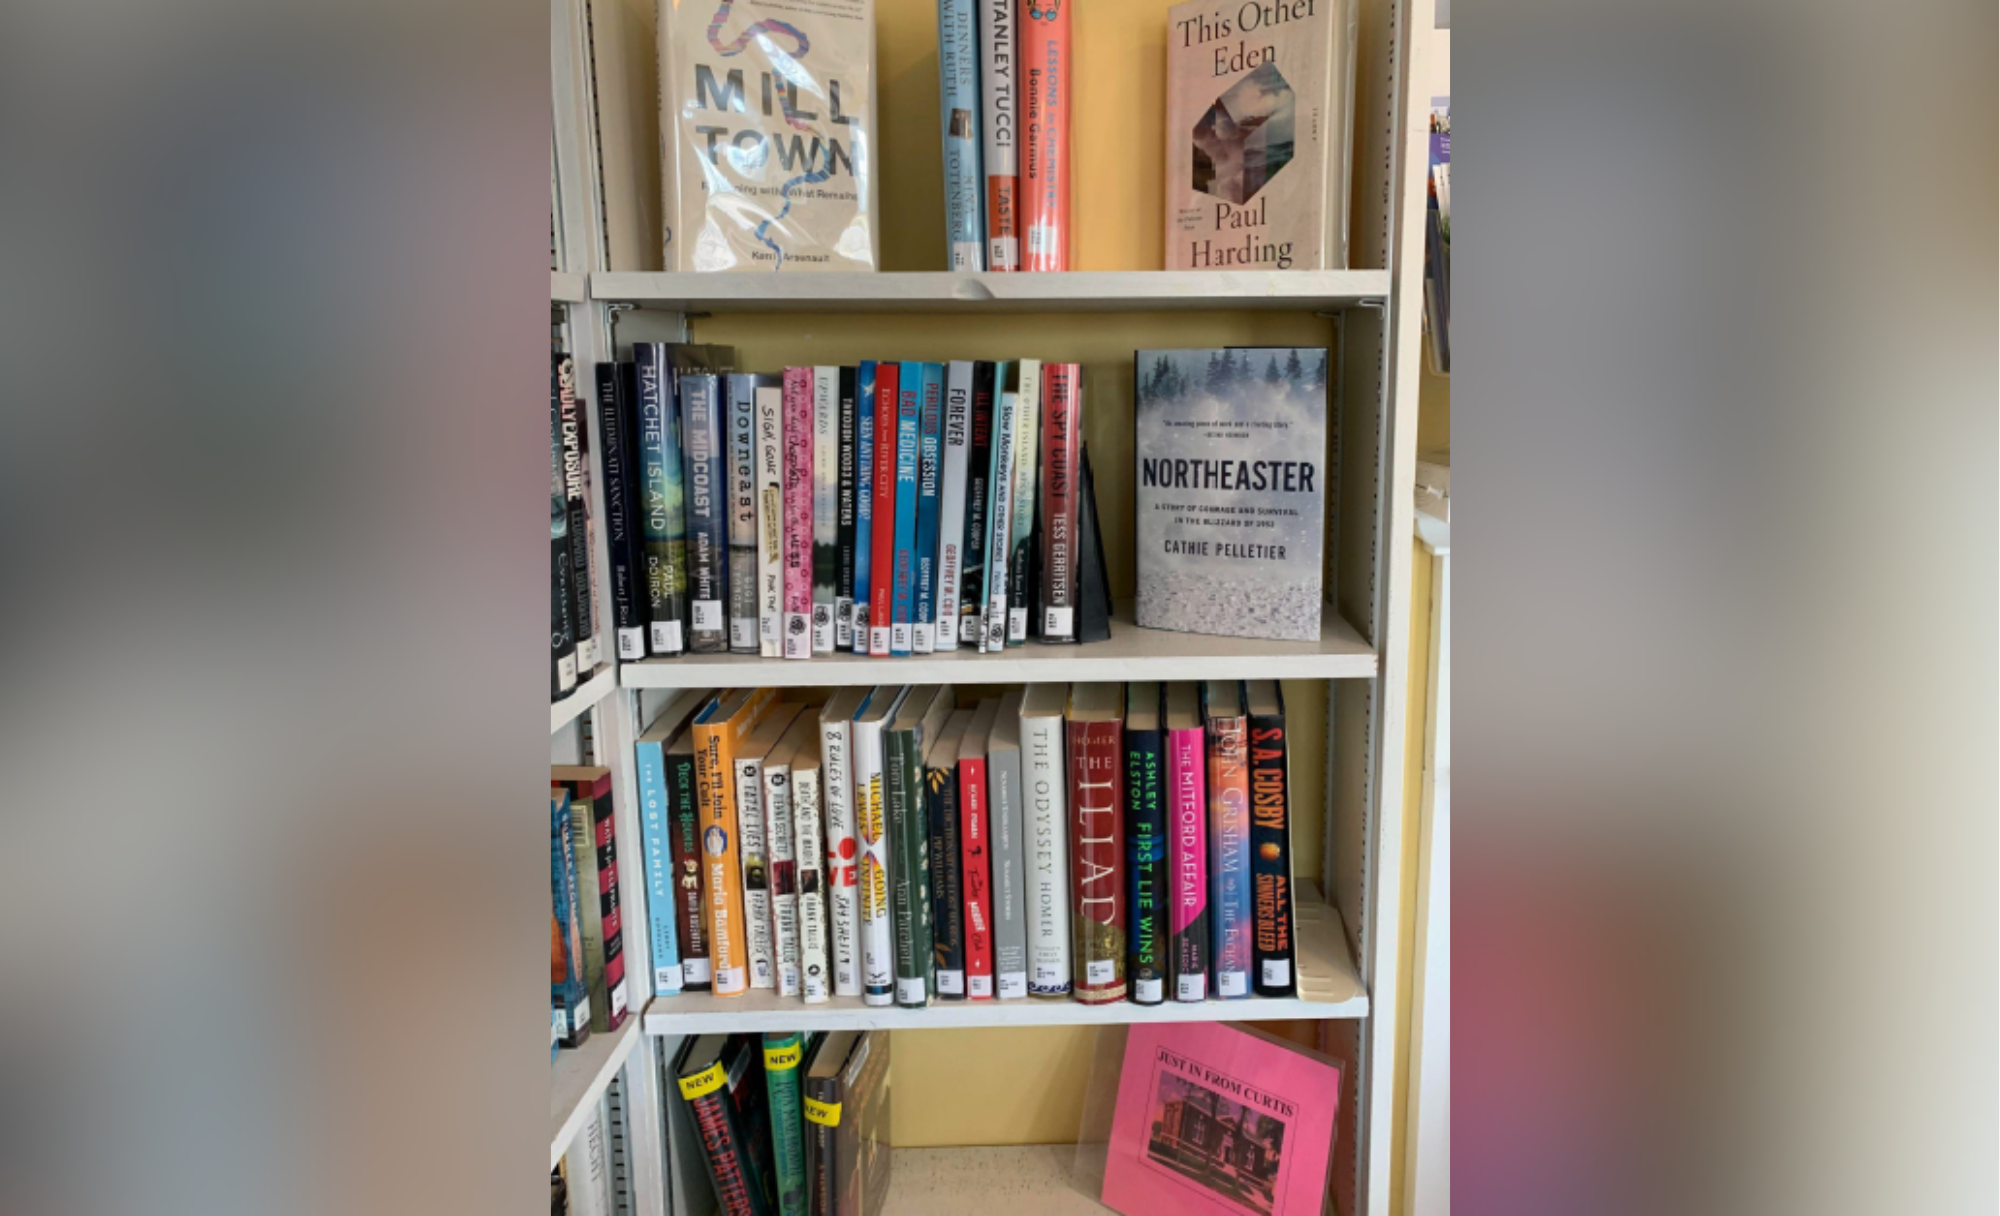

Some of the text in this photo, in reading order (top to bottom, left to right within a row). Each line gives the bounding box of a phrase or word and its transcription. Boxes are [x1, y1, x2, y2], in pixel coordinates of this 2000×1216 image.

[957, 12, 972, 85] DINNERS
[1177, 0, 1315, 48] This Other
[946, 51, 957, 97] RUTH
[1047, 40, 1059, 107] LESSONS
[1211, 40, 1276, 77] Eden
[695, 64, 859, 125] MILL
[995, 84, 1011, 147] TUCCI
[1029, 69, 1041, 119] Bonnie
[696, 126, 861, 176] TOWN
[998, 185, 1012, 236] TASTE
[1215, 196, 1266, 231] Paul
[1190, 235, 1294, 270] Harding
[642, 365, 666, 530] HATCHET ISLAND
[898, 390, 916, 482] BAD MEDICINE
[922, 383, 939, 497] PERILOUS OBSESSION
[948, 388, 966, 447] FOREVER
[999, 405, 1013, 482] Slow Monkeys
[1050, 374, 1068, 499] THE SPY COAST
[562, 421, 582, 502] EXPOSURE
[602, 382, 613, 402] THE
[610, 478, 625, 541] SANCTION
[691, 389, 710, 518] THE MIDCOAST
[737, 401, 754, 521] Downeast
[841, 398, 854, 526] THROUGH WOODS WATERS
[1143, 458, 1315, 492] NORTHEASTER
[879, 474, 889, 498] CITY
[1161, 503, 1186, 512] STORY
[1187, 504, 1198, 512] OF
[1199, 505, 1236, 514] COURAGE
[1238, 506, 1255, 515] AND
[1257, 507, 1299, 516] SURVIVAL
[697, 532, 708, 562] ADAM
[1052, 513, 1067, 540] TESS
[1164, 539, 1286, 560] CATHIE PELLETIER
[1174, 516, 1184, 524] IN
[1186, 517, 1201, 525] THE
[649, 557, 661, 608] DOIRON
[944, 544, 957, 585] GEOFFREY
[1052, 543, 1067, 603] GERRITSEN
[697, 749, 712, 807] Your Cult
[709, 735, 727, 819] Sure, I'll Join
[1033, 729, 1050, 769] THE
[1076, 756, 1113, 770] THE
[1251, 727, 1285, 830] S. A. COSBY
[677, 761, 694, 853] DECK THE HOUNDS
[826, 731, 844, 830] 8 RULES OF LOVE
[870, 772, 884, 838] MICHAEL
[890, 753, 908, 825] Tom Lake
[1130, 751, 1141, 810] ELSTON
[1145, 751, 1156, 810] ASHLEY
[647, 789, 664, 898] LOST FAMILY
[744, 785, 761, 847] FATAL LIES
[1035, 780, 1051, 874] ODYSSEY
[1181, 744, 1198, 908] THE MITFORD AFFAIR
[1222, 787, 1244, 873] GRISHAM
[1078, 779, 1116, 926] ILIAD
[711, 862, 727, 906] Maria
[835, 894, 850, 918] JAY
[874, 868, 887, 919] GOING
[1040, 881, 1053, 937] HOMER
[1137, 822, 1154, 964] FIRST LIE WINS
[1256, 873, 1289, 952] ALL THE SINNERS BLEED
[714, 909, 732, 970] Bamford
[780, 903, 793, 933] FRANK
[897, 876, 914, 966] Ann Patchett
[686, 1072, 715, 1090] NEW
[769, 1053, 797, 1065] NEW
[1158, 1051, 1294, 1117] JUST IN FROM CURTIS
[693, 1096, 731, 1152] JAMES
